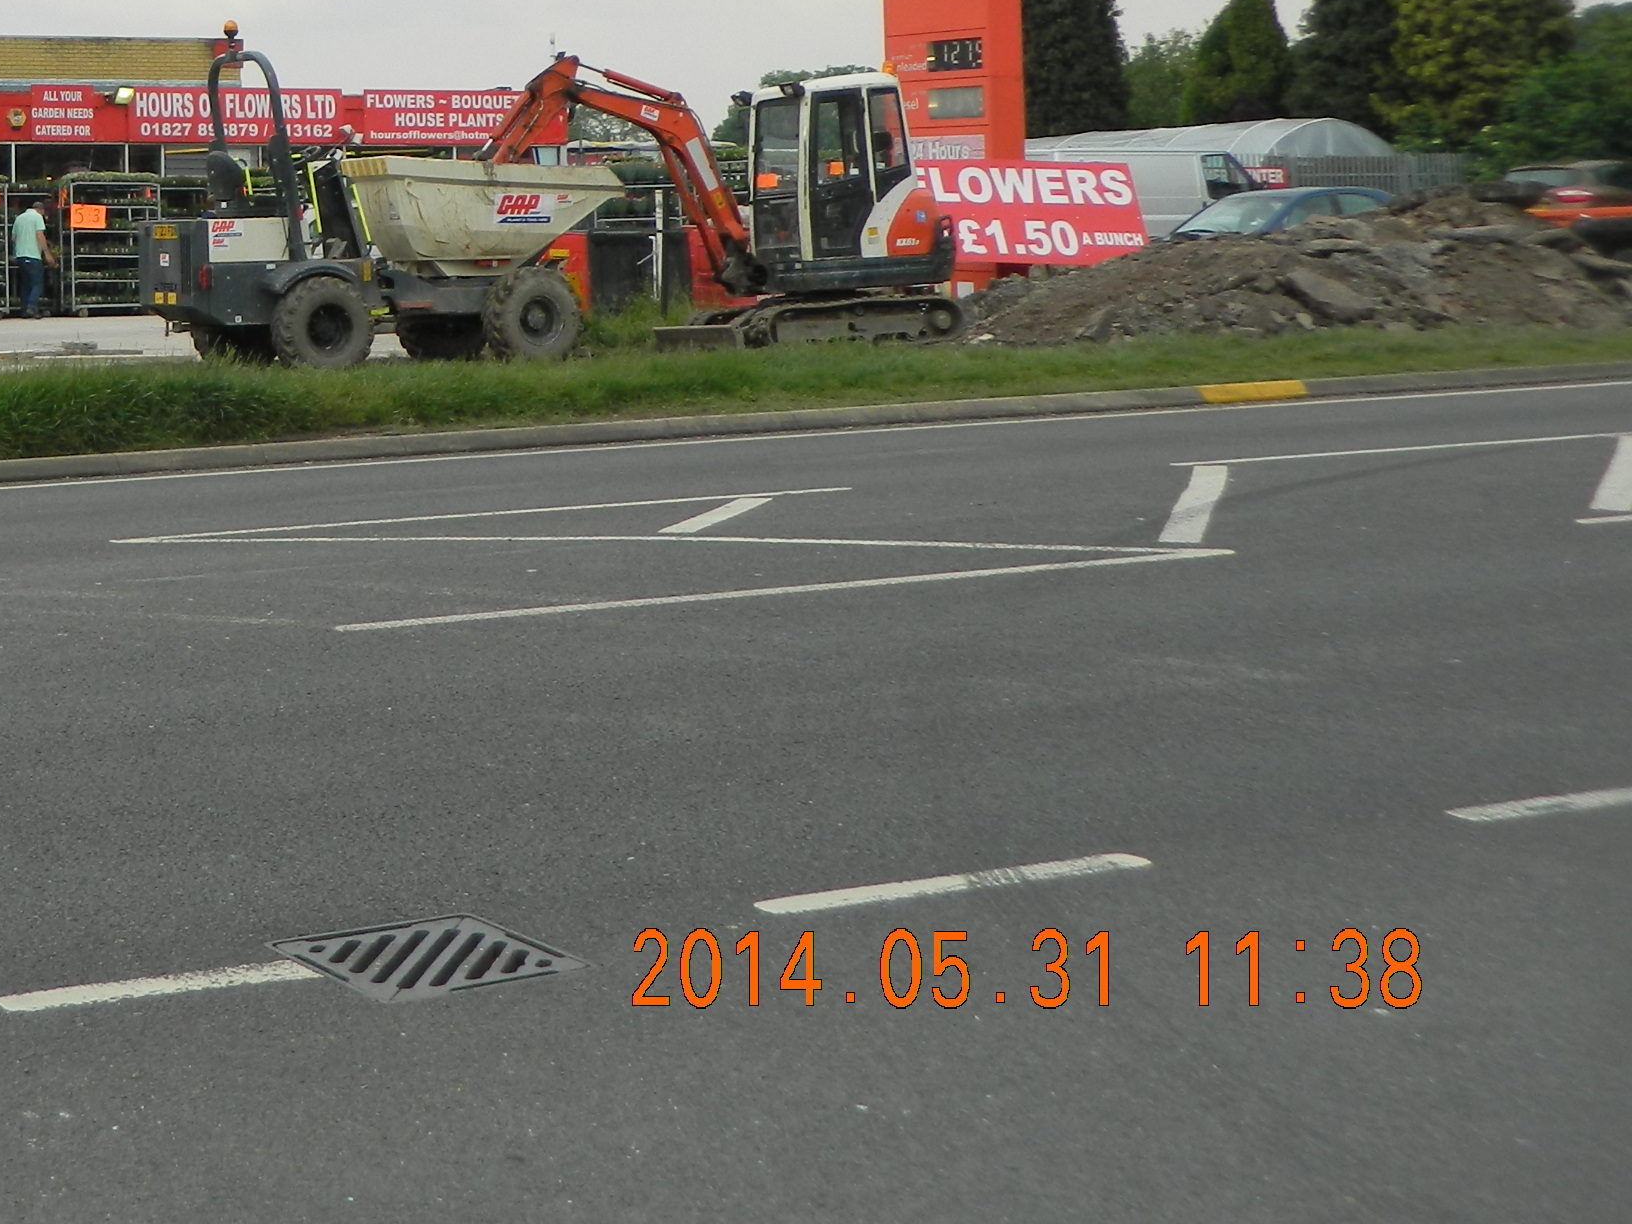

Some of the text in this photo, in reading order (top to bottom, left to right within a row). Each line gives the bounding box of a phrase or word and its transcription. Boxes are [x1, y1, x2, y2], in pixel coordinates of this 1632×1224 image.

[897, 62, 927, 71] nleaded
[42, 90, 83, 102] ALL YOUR
[367, 94, 435, 108] FLOWERS
[451, 95, 519, 109] BOUQUET
[136, 92, 194, 118] HOURS
[225, 92, 302, 119] FLOWRS
[306, 94, 336, 119] LTD
[31, 107, 65, 119] GARDEN
[66, 107, 94, 119] NEEDS
[394, 112, 505, 127] HOUSE PLANTS
[35, 125, 91, 137] CATERED FOR
[140, 122, 192, 137] 01827
[274, 122, 333, 138] 13162
[370, 130, 492, 140] hoursofflowers@hotm
[958, 219, 1144, 256] £1.50 A BUNCH
